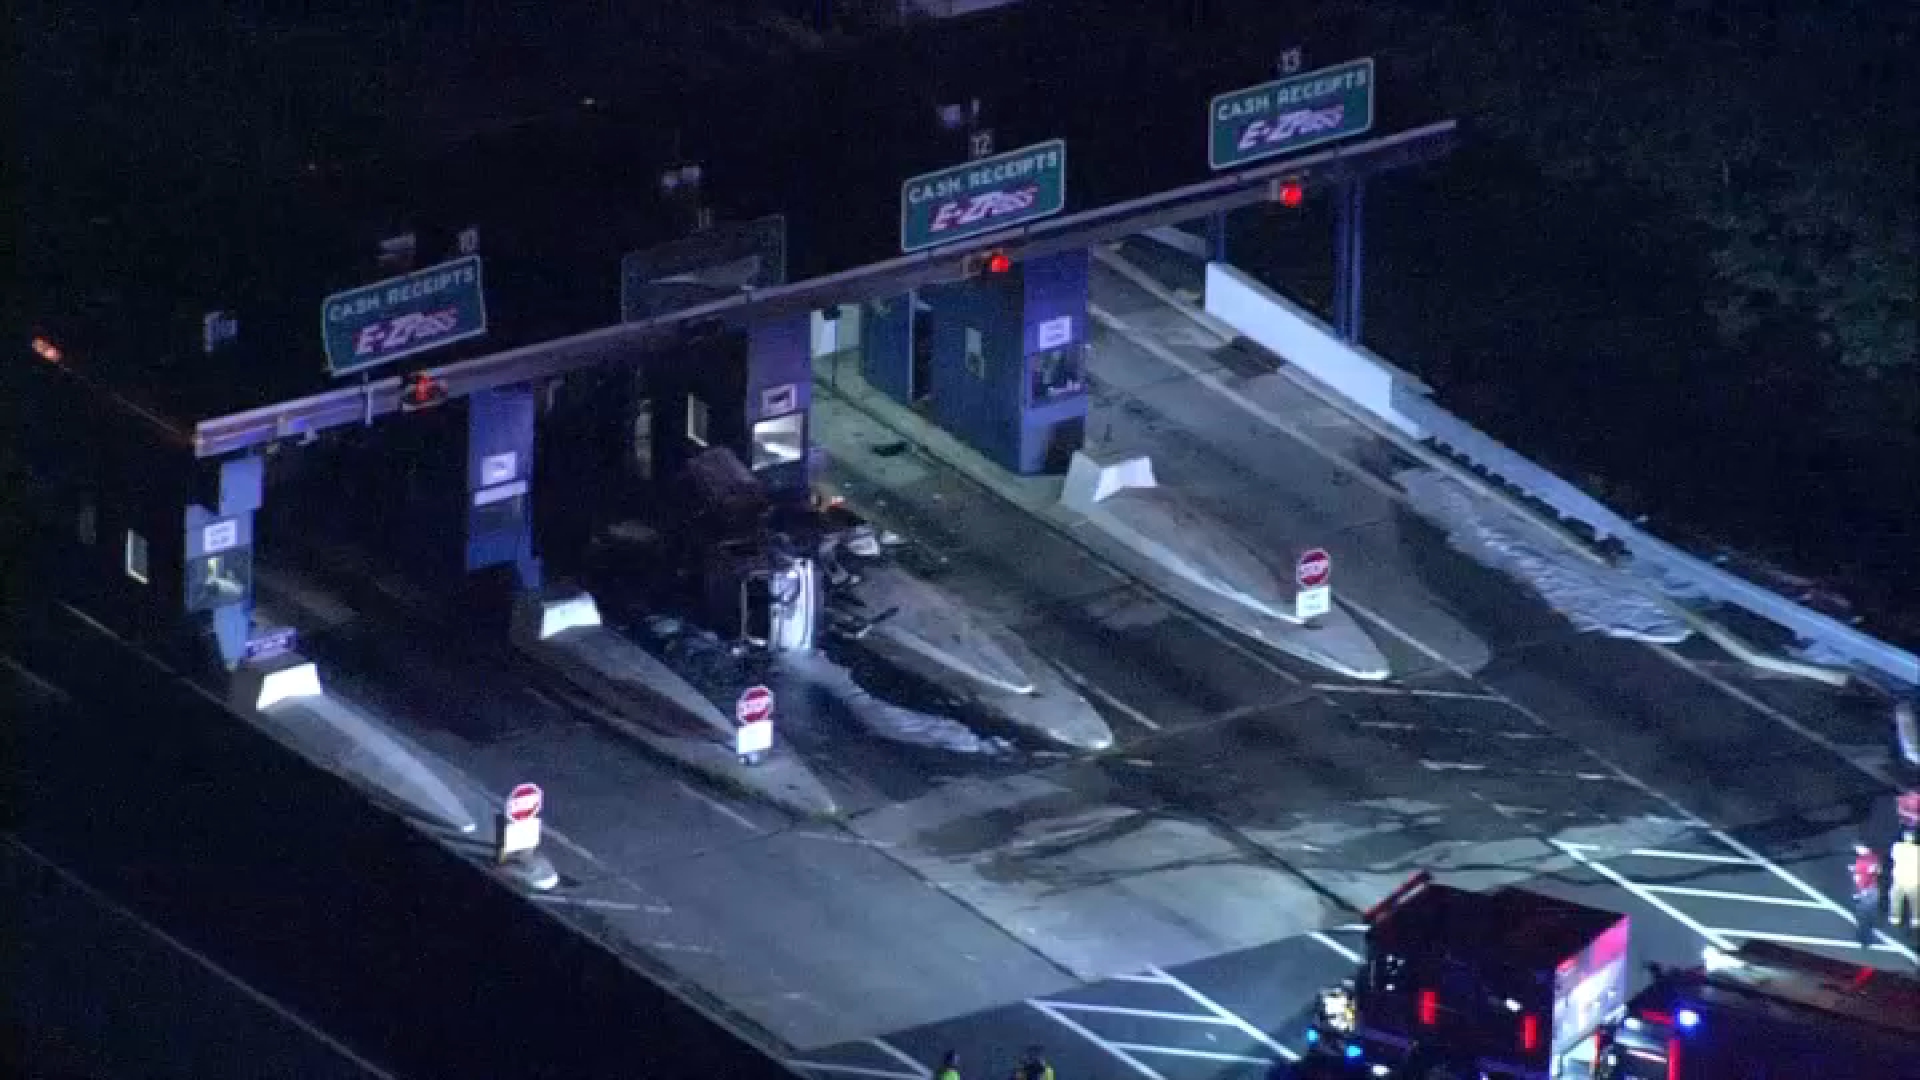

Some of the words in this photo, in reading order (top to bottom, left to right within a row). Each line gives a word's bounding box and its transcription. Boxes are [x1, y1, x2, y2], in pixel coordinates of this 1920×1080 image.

[1218, 96, 1270, 120] CASH
[1278, 69, 1366, 104] RECEIPTS
[970, 132, 990, 155] 12
[909, 178, 960, 204] CASH
[969, 152, 1057, 187] RECEIPTS
[459, 228, 479, 252] 10
[330, 294, 380, 321] CASH
[387, 266, 475, 304] RECEIPTS
